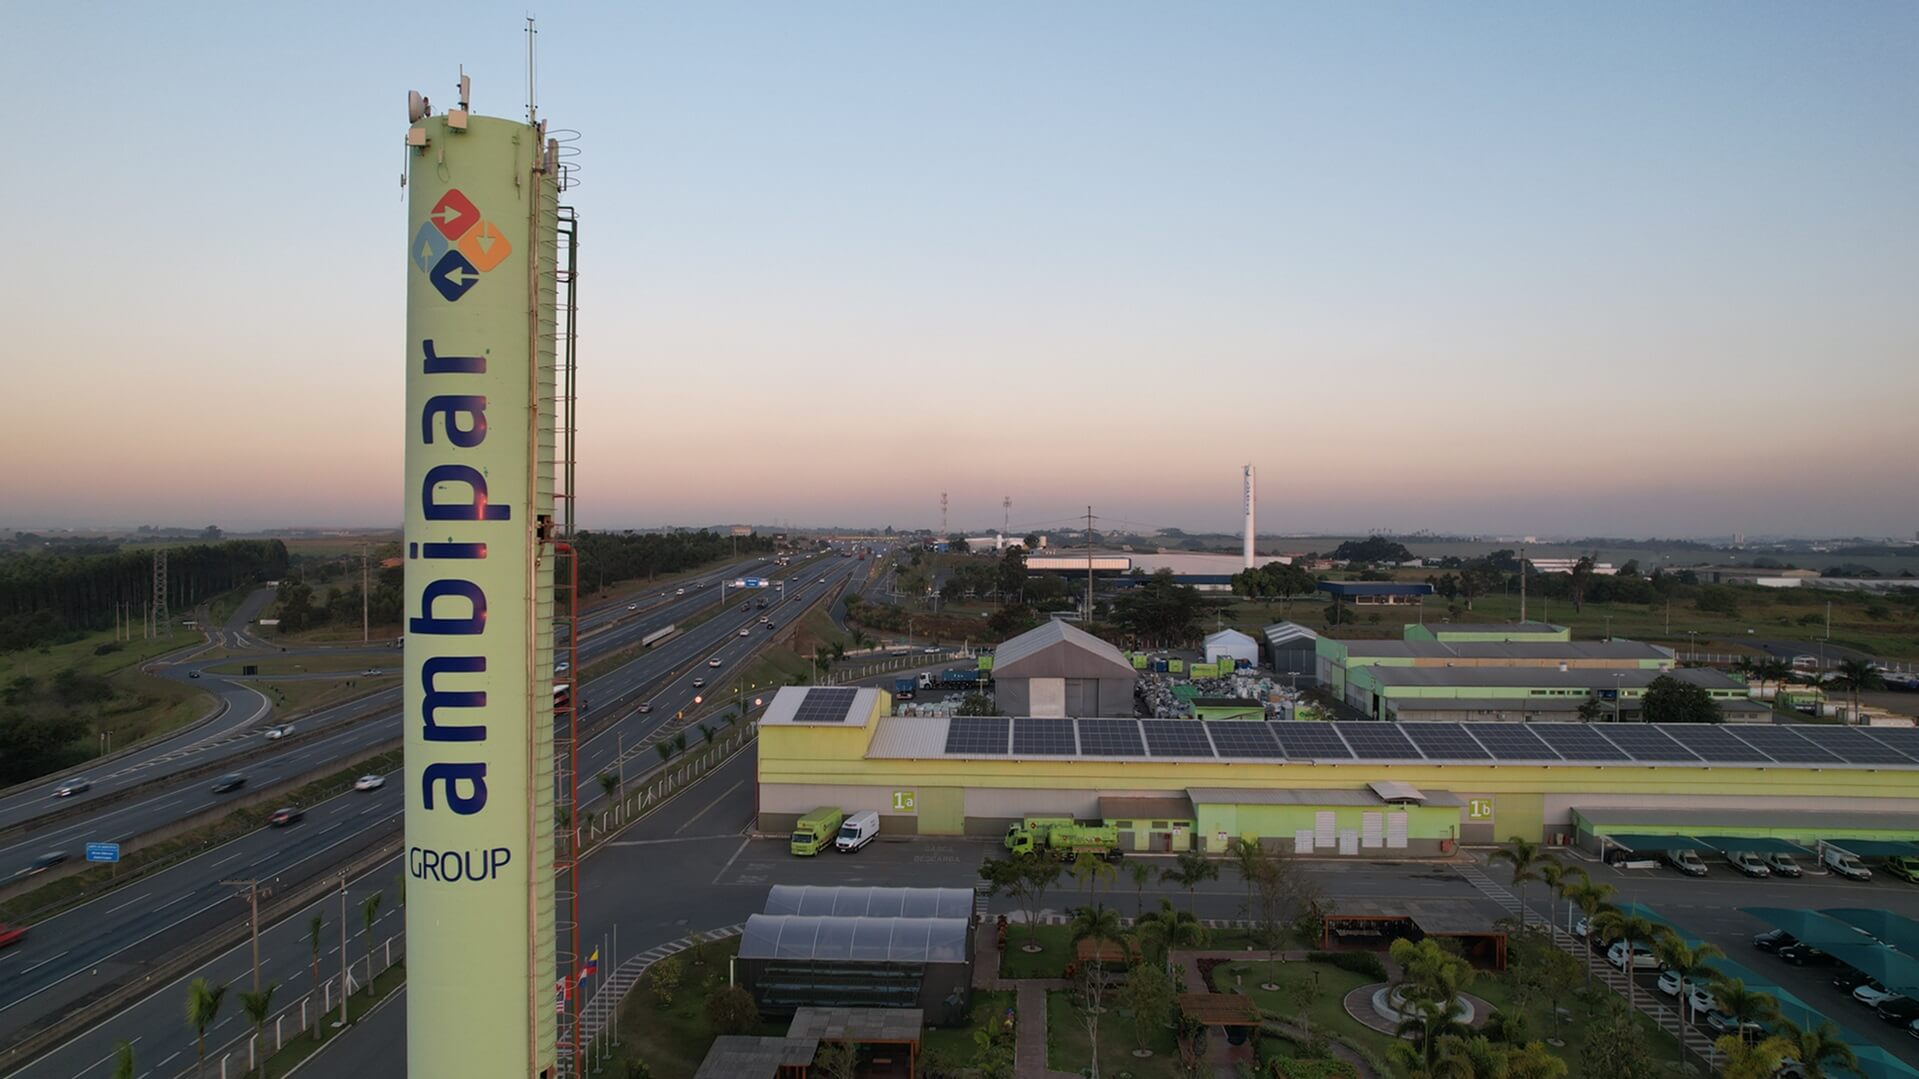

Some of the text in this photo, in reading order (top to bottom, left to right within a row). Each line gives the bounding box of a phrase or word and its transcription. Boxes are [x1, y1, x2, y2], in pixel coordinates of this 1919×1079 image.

[409, 339, 511, 815] ambipar
[894, 791, 914, 809] 1a
[1470, 799, 1491, 817] 1b
[409, 847, 511, 882] GROUP
